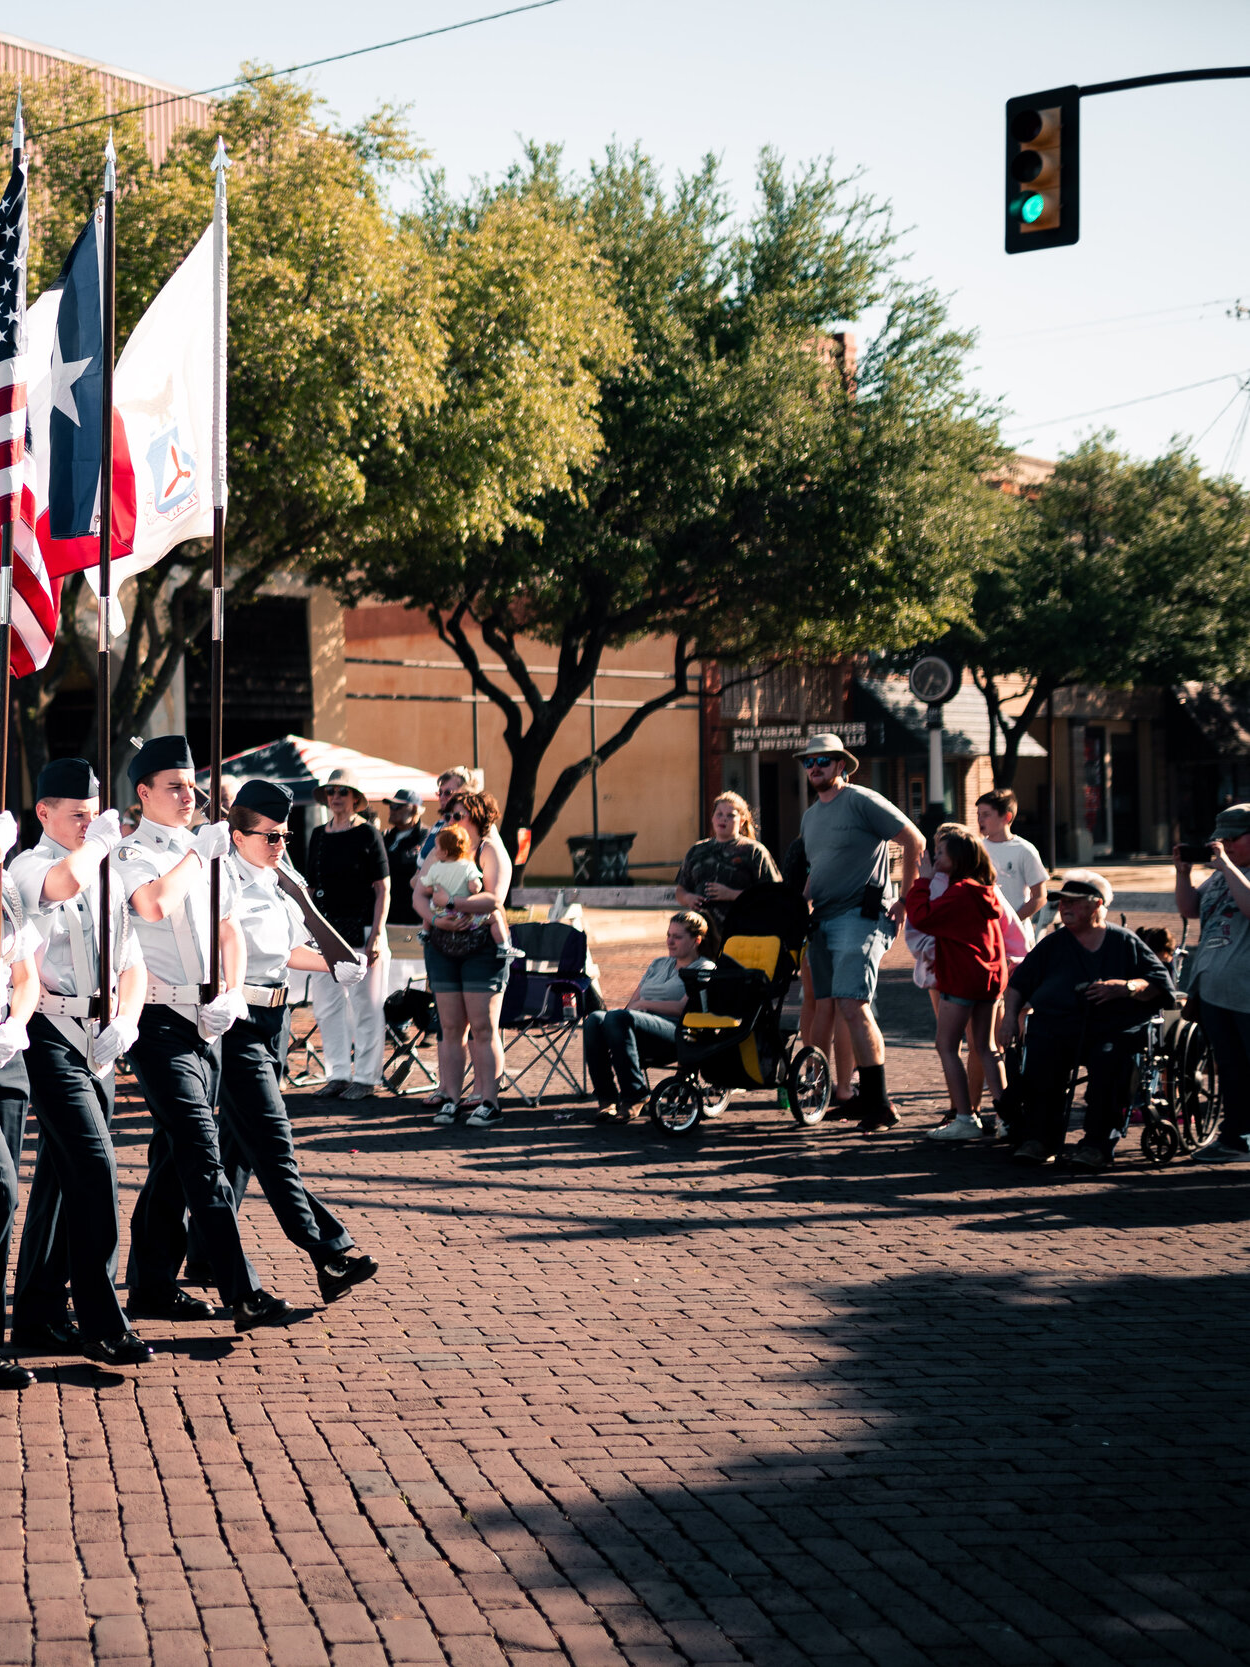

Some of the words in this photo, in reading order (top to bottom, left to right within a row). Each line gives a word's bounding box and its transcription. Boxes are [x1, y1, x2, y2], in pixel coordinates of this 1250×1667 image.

[733, 725, 801, 739] POLYGRAPH
[807, 722, 867, 735] SERVICES
[734, 740, 754, 752] AND
